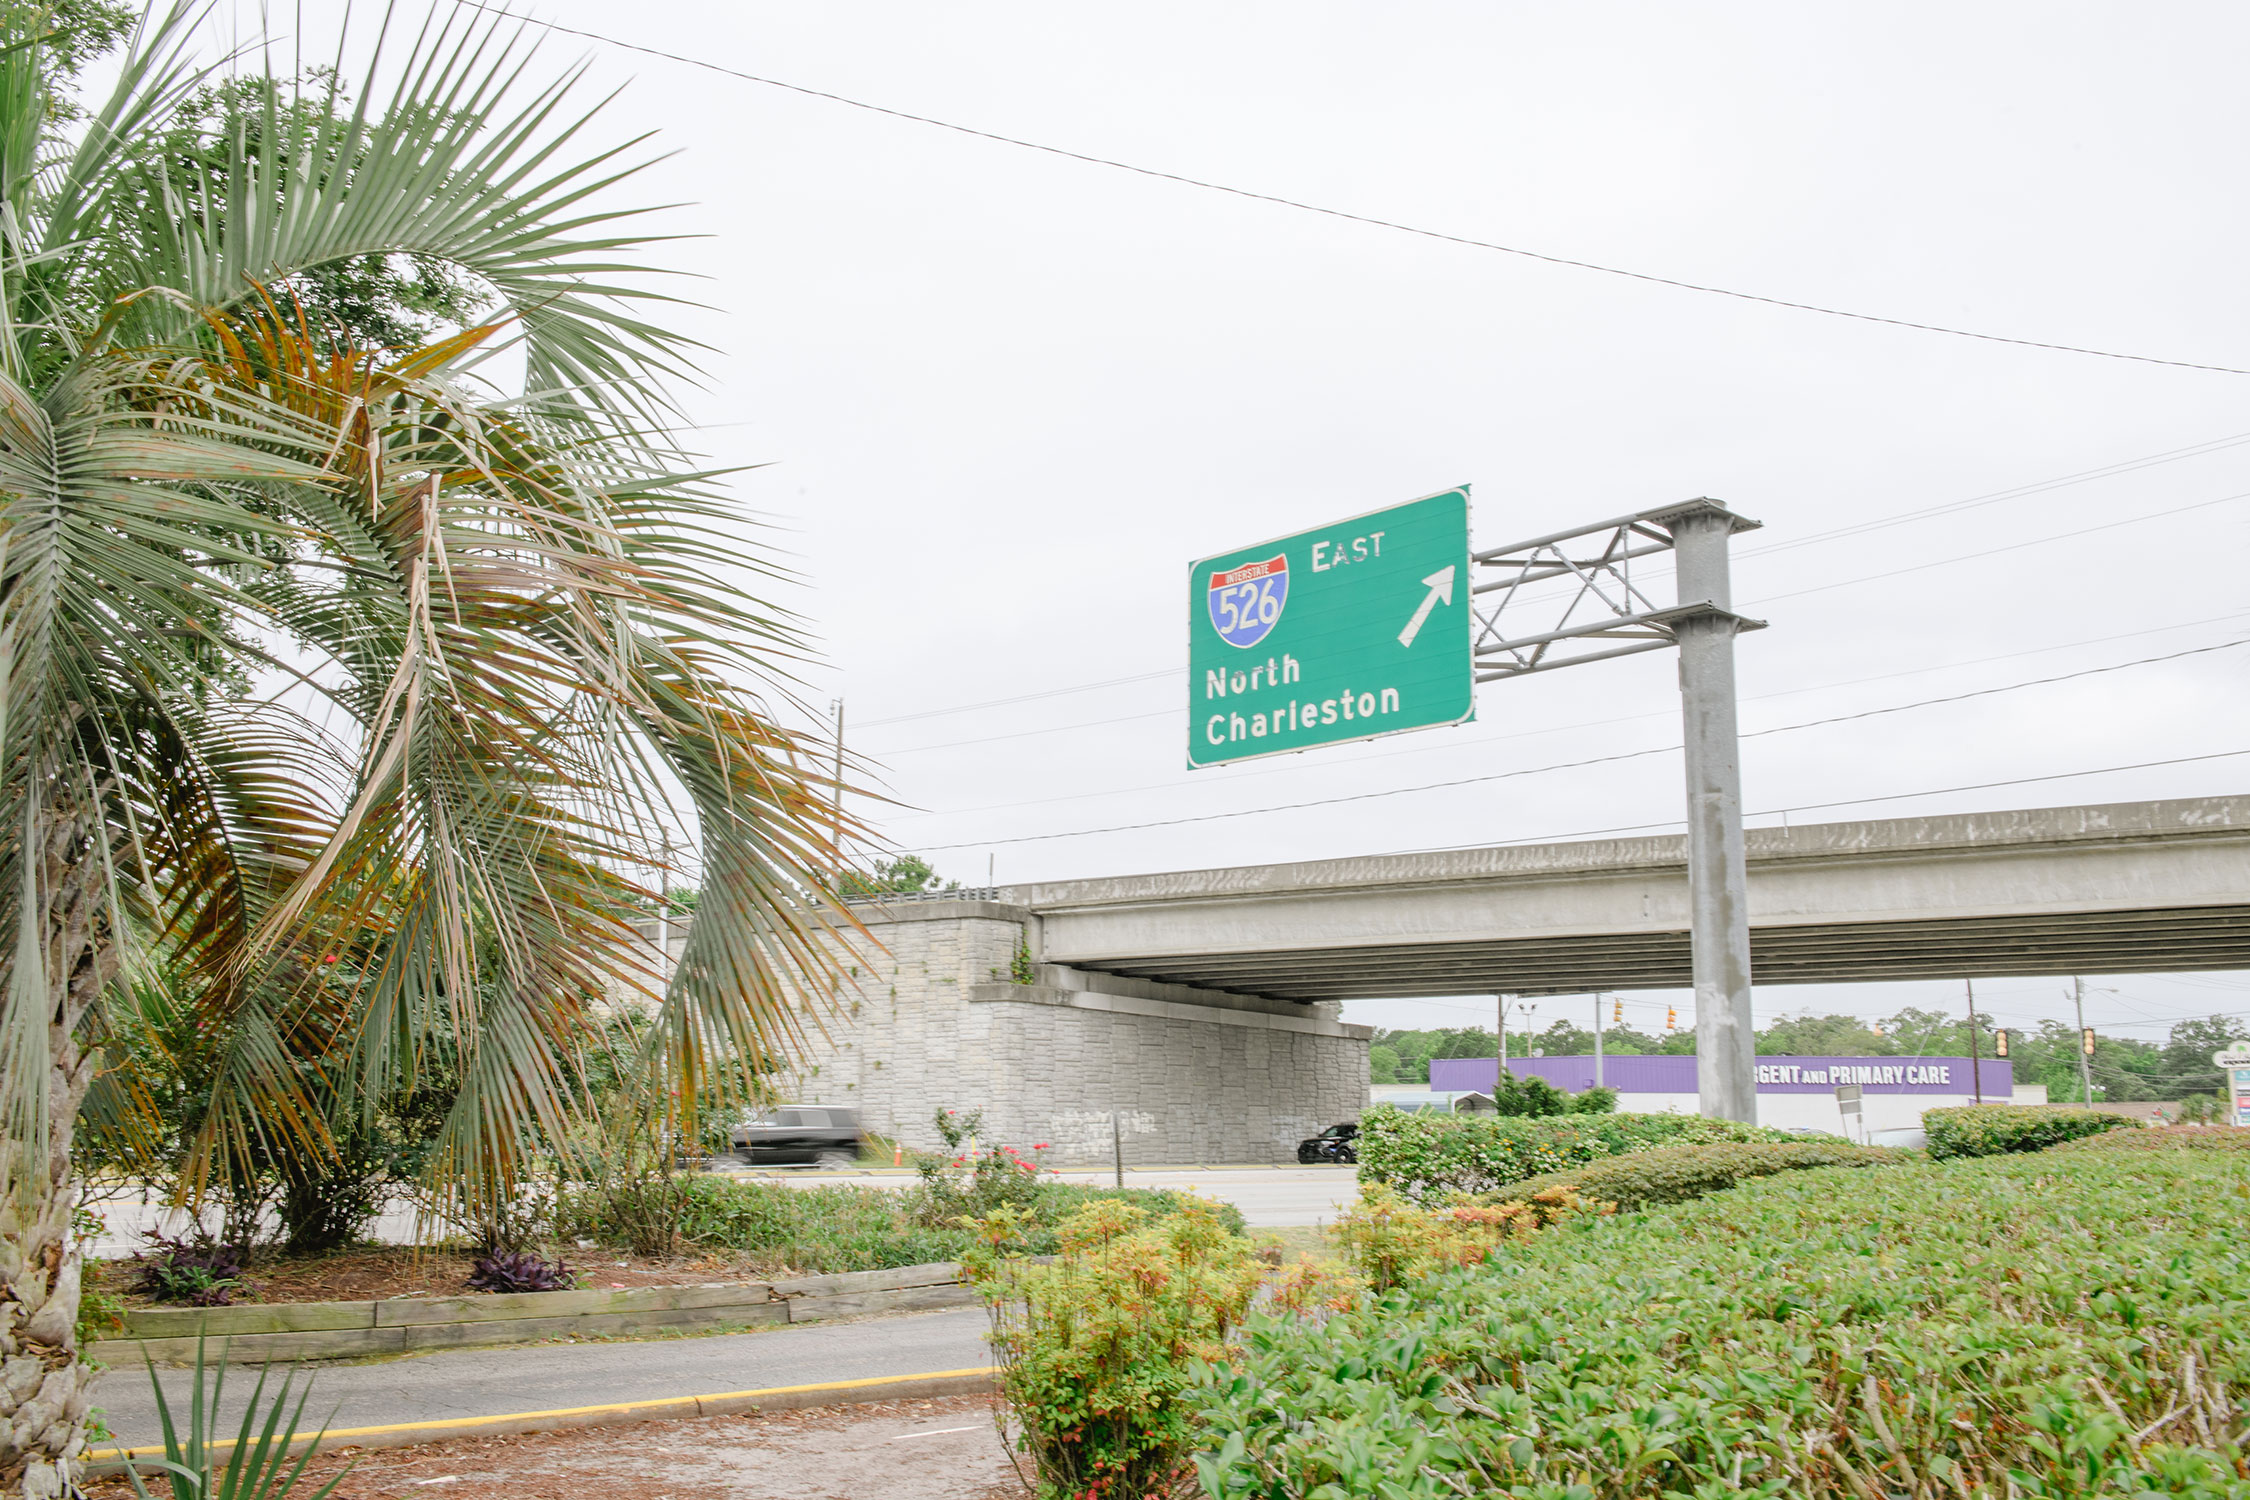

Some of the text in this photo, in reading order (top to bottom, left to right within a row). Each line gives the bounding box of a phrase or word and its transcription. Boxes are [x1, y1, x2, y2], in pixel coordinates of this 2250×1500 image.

[1312, 532, 1385, 573] EAST
[1225, 564, 1270, 585] INTERSTATE
[1219, 578, 1279, 635] 526
[1206, 653, 1300, 699] North
[1206, 687, 1400, 745] Charleston
[1802, 1071, 1828, 1084] AND
[1828, 1066, 1904, 1085] PRIMARY
[1905, 1066, 1951, 1085] CARE
